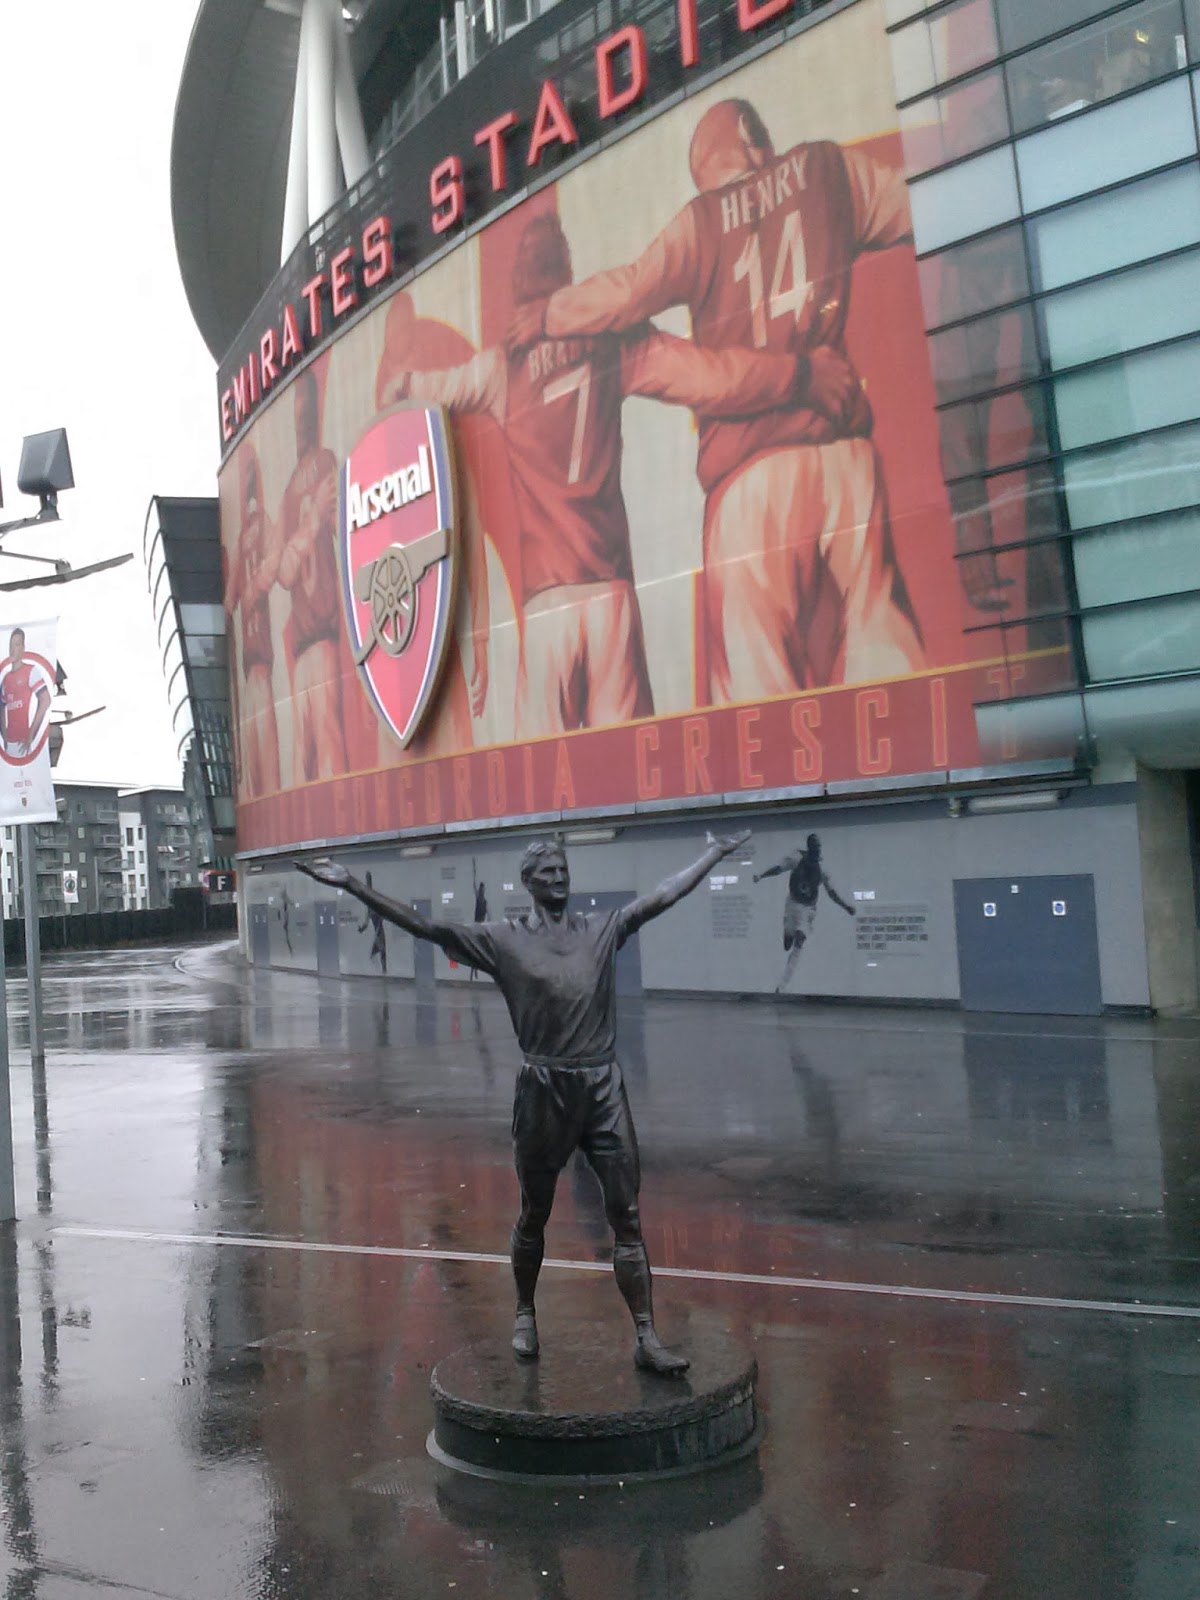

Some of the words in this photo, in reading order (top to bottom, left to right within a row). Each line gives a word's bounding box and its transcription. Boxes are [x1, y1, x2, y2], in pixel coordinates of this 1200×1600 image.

[720, 150, 808, 233] HENRY
[221, 215, 393, 442] EMIRATES
[733, 209, 813, 348] 14
[543, 363, 591, 484] 7
[348, 444, 431, 533] Arsenal
[217, 875, 227, 891] F
